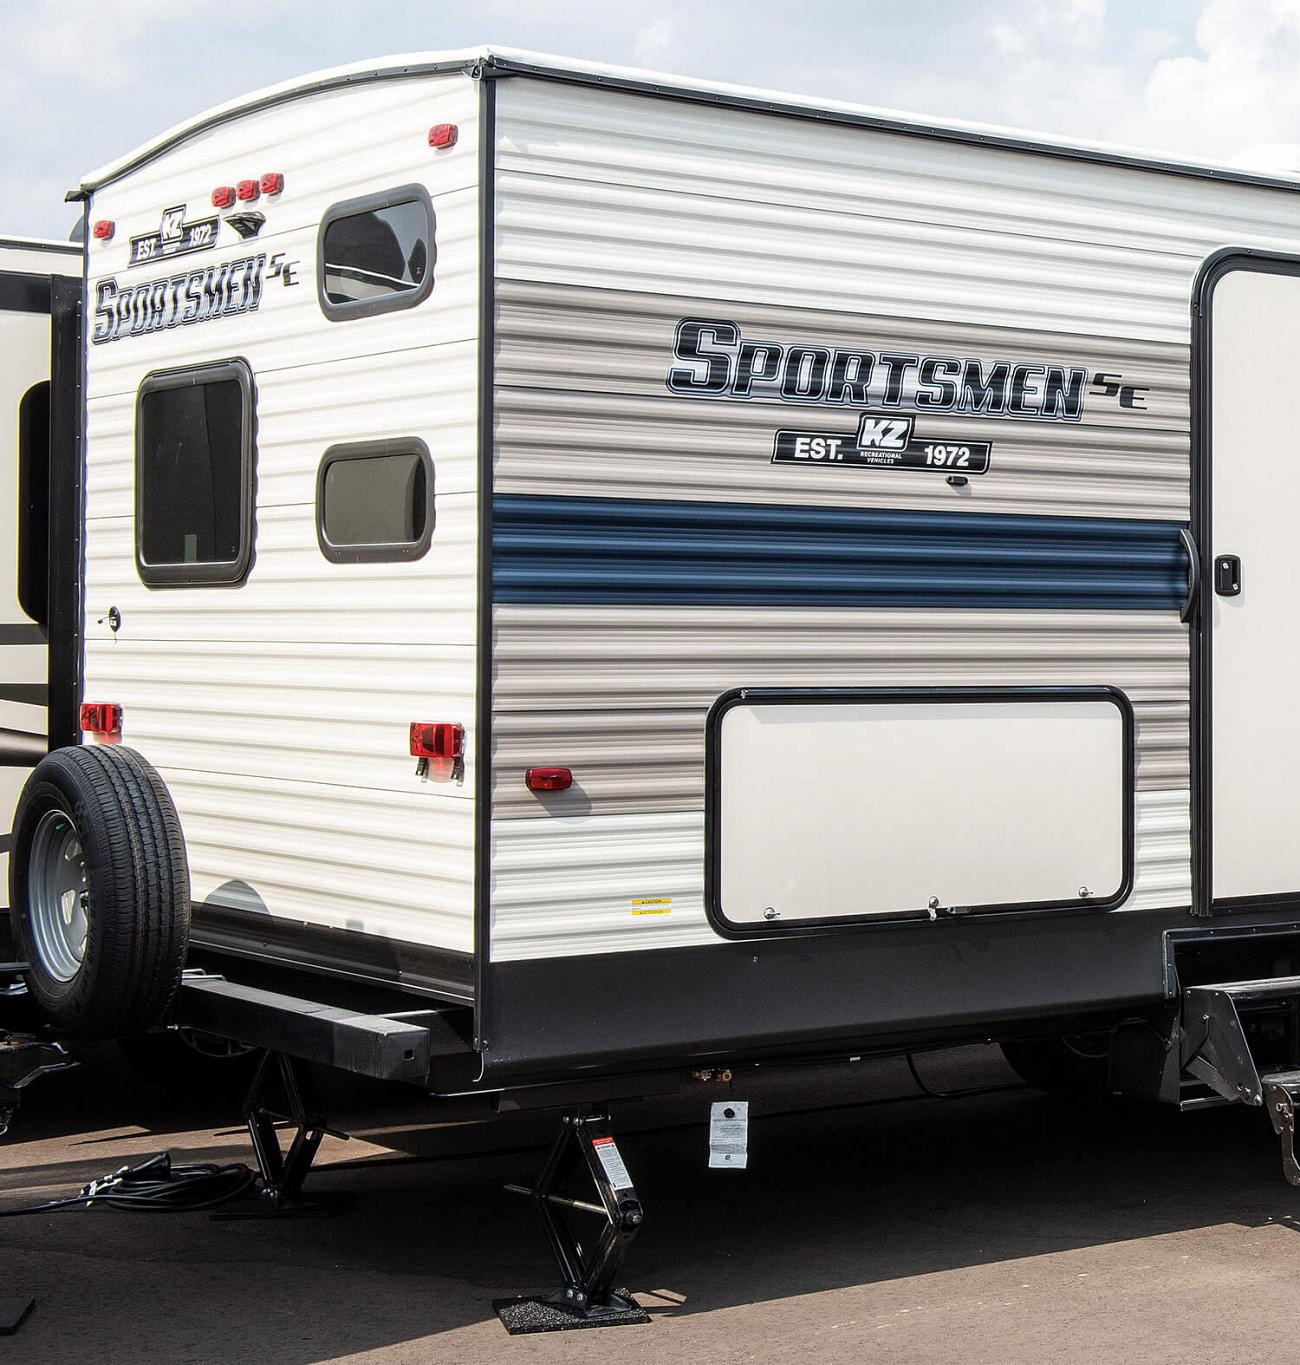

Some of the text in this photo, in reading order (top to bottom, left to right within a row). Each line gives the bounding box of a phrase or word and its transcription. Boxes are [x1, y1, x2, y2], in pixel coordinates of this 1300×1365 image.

[163, 210, 183, 241] KZ
[136, 239, 157, 260] EST.
[189, 223, 212, 248] 1972
[92, 253, 267, 345] SPORTSMEN
[666, 316, 1150, 421] SPORTSMEN SE
[861, 418, 909, 447] KZ
[794, 437, 970, 467] EST. 1972
[860, 450, 902, 459] RECREATIONAL
